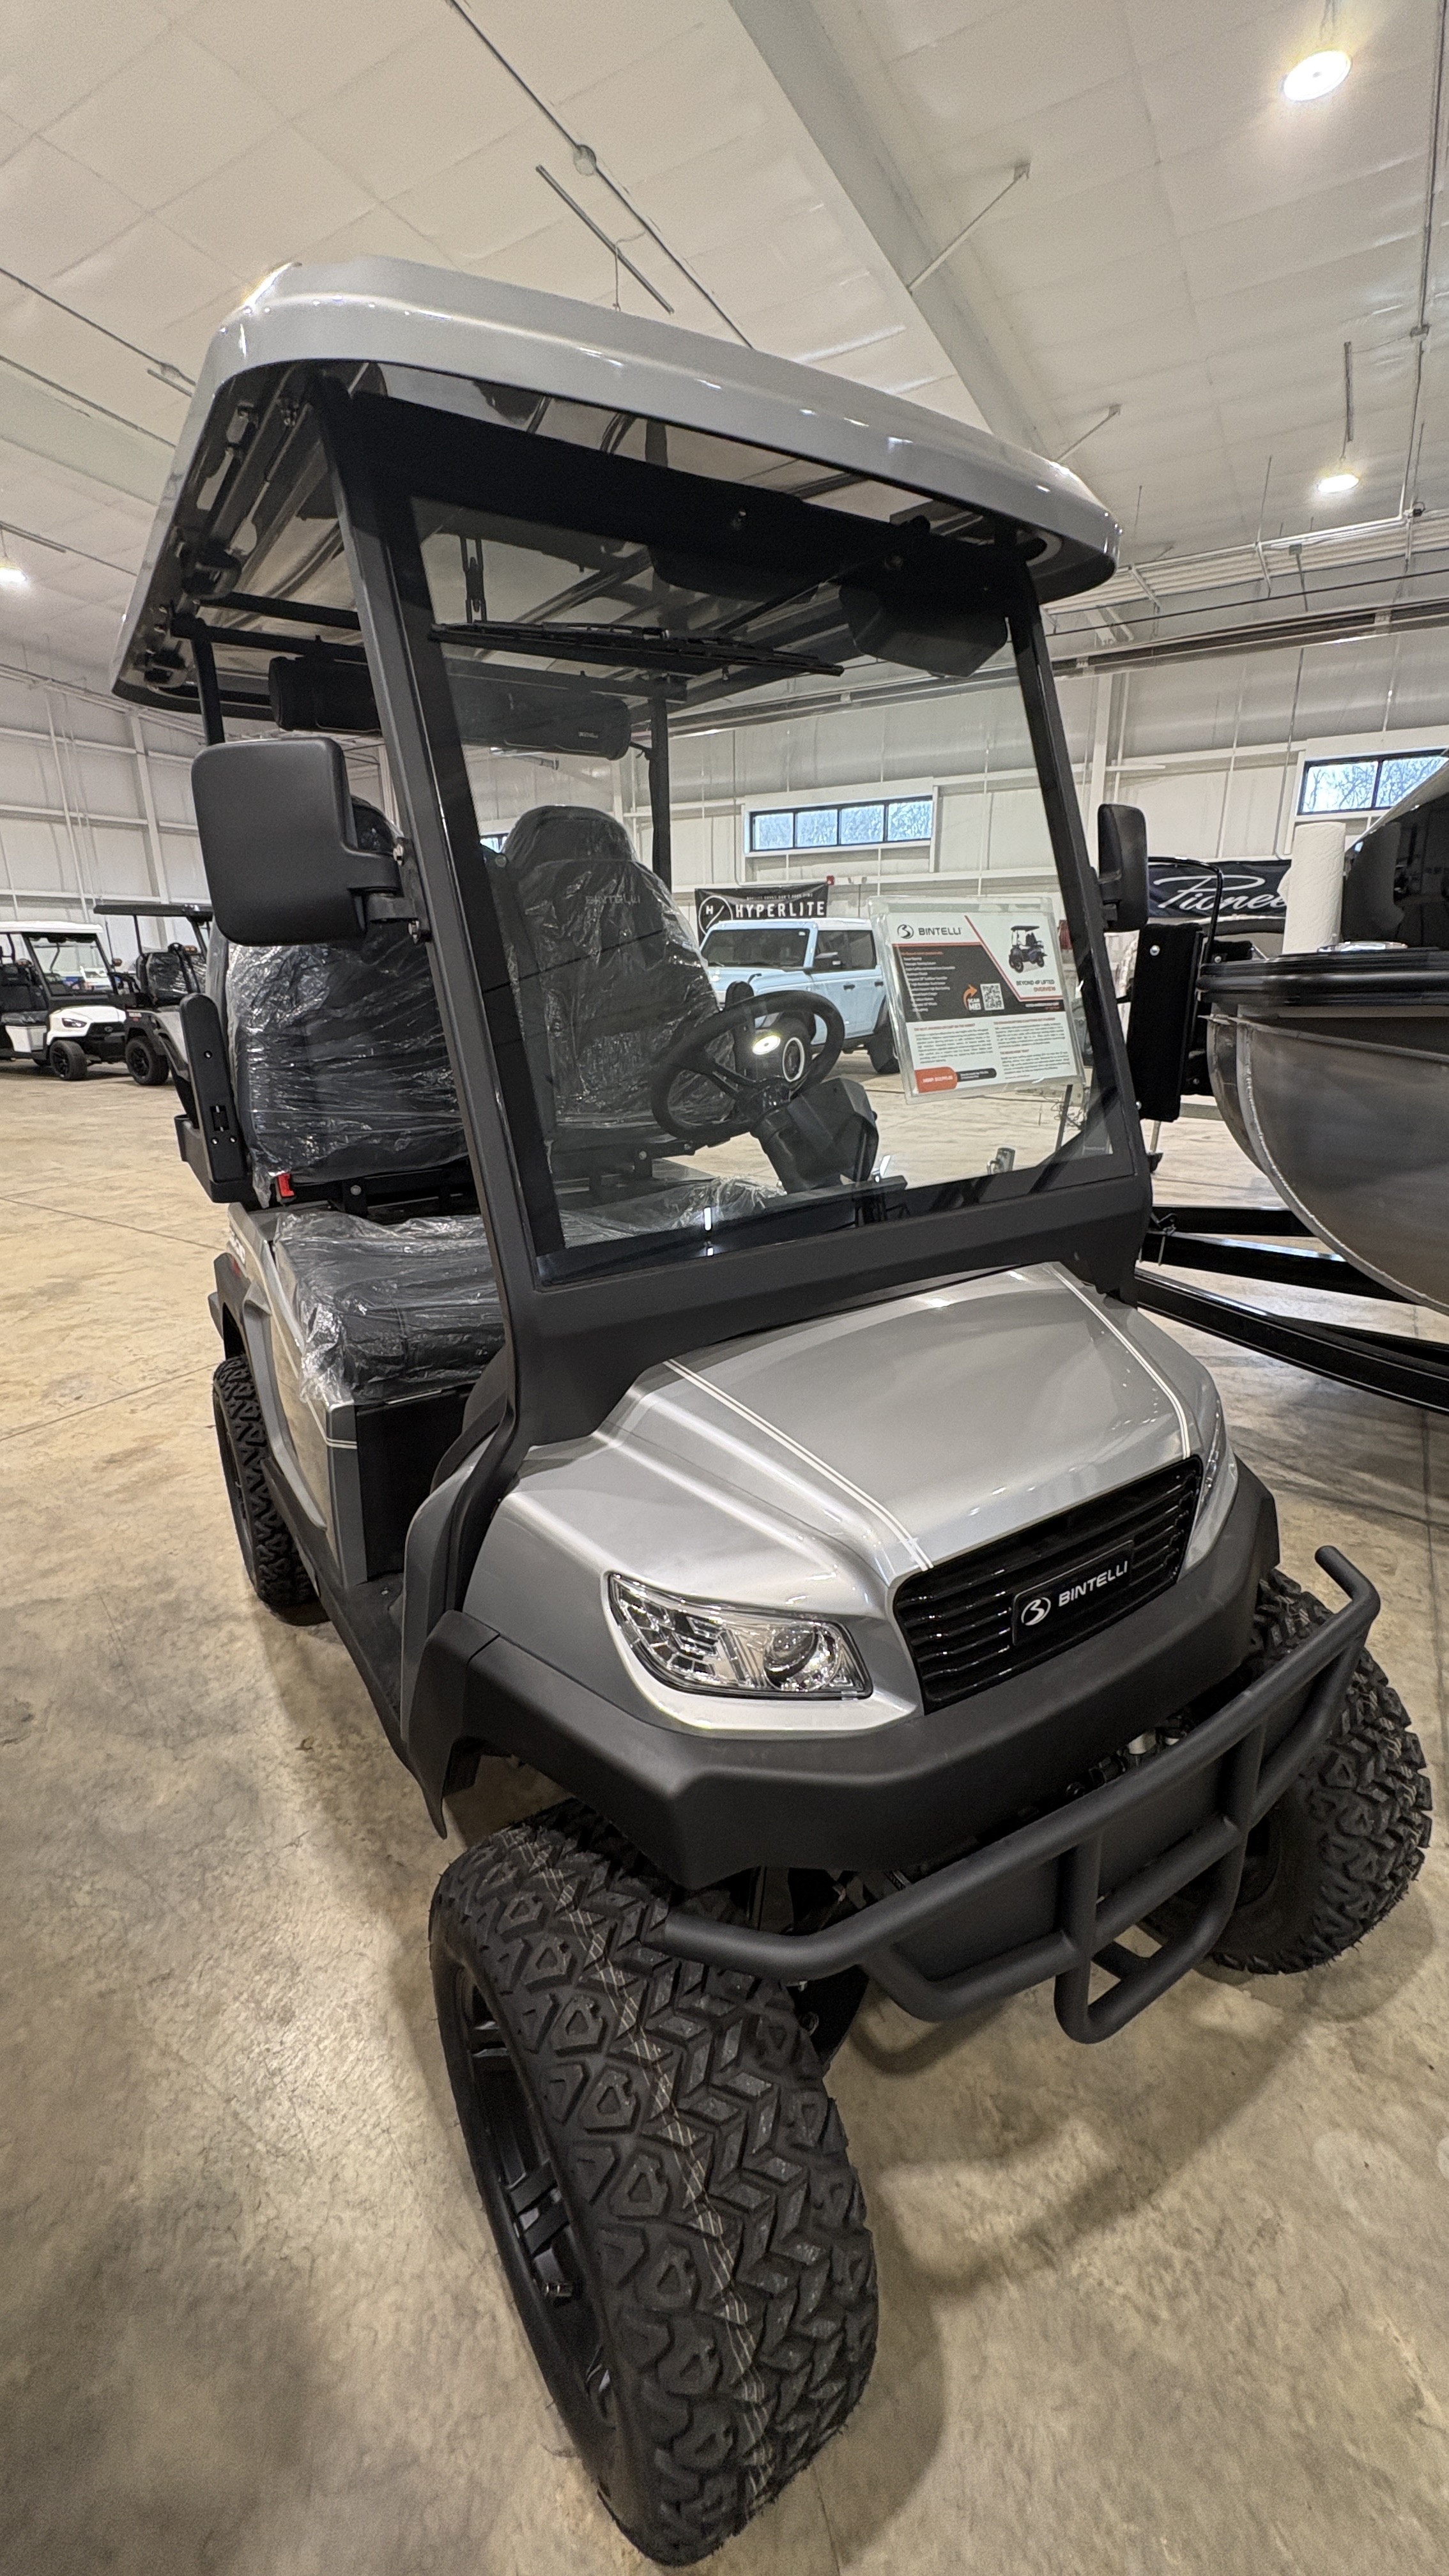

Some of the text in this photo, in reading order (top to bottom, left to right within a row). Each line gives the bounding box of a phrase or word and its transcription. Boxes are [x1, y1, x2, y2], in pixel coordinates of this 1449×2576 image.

[1153, 875, 1287, 910] Pionee
[735, 901, 825, 918] HYPERLITE
[918, 927, 961, 936] BINTELLI
[1058, 1560, 1128, 1607] BINTELLI
